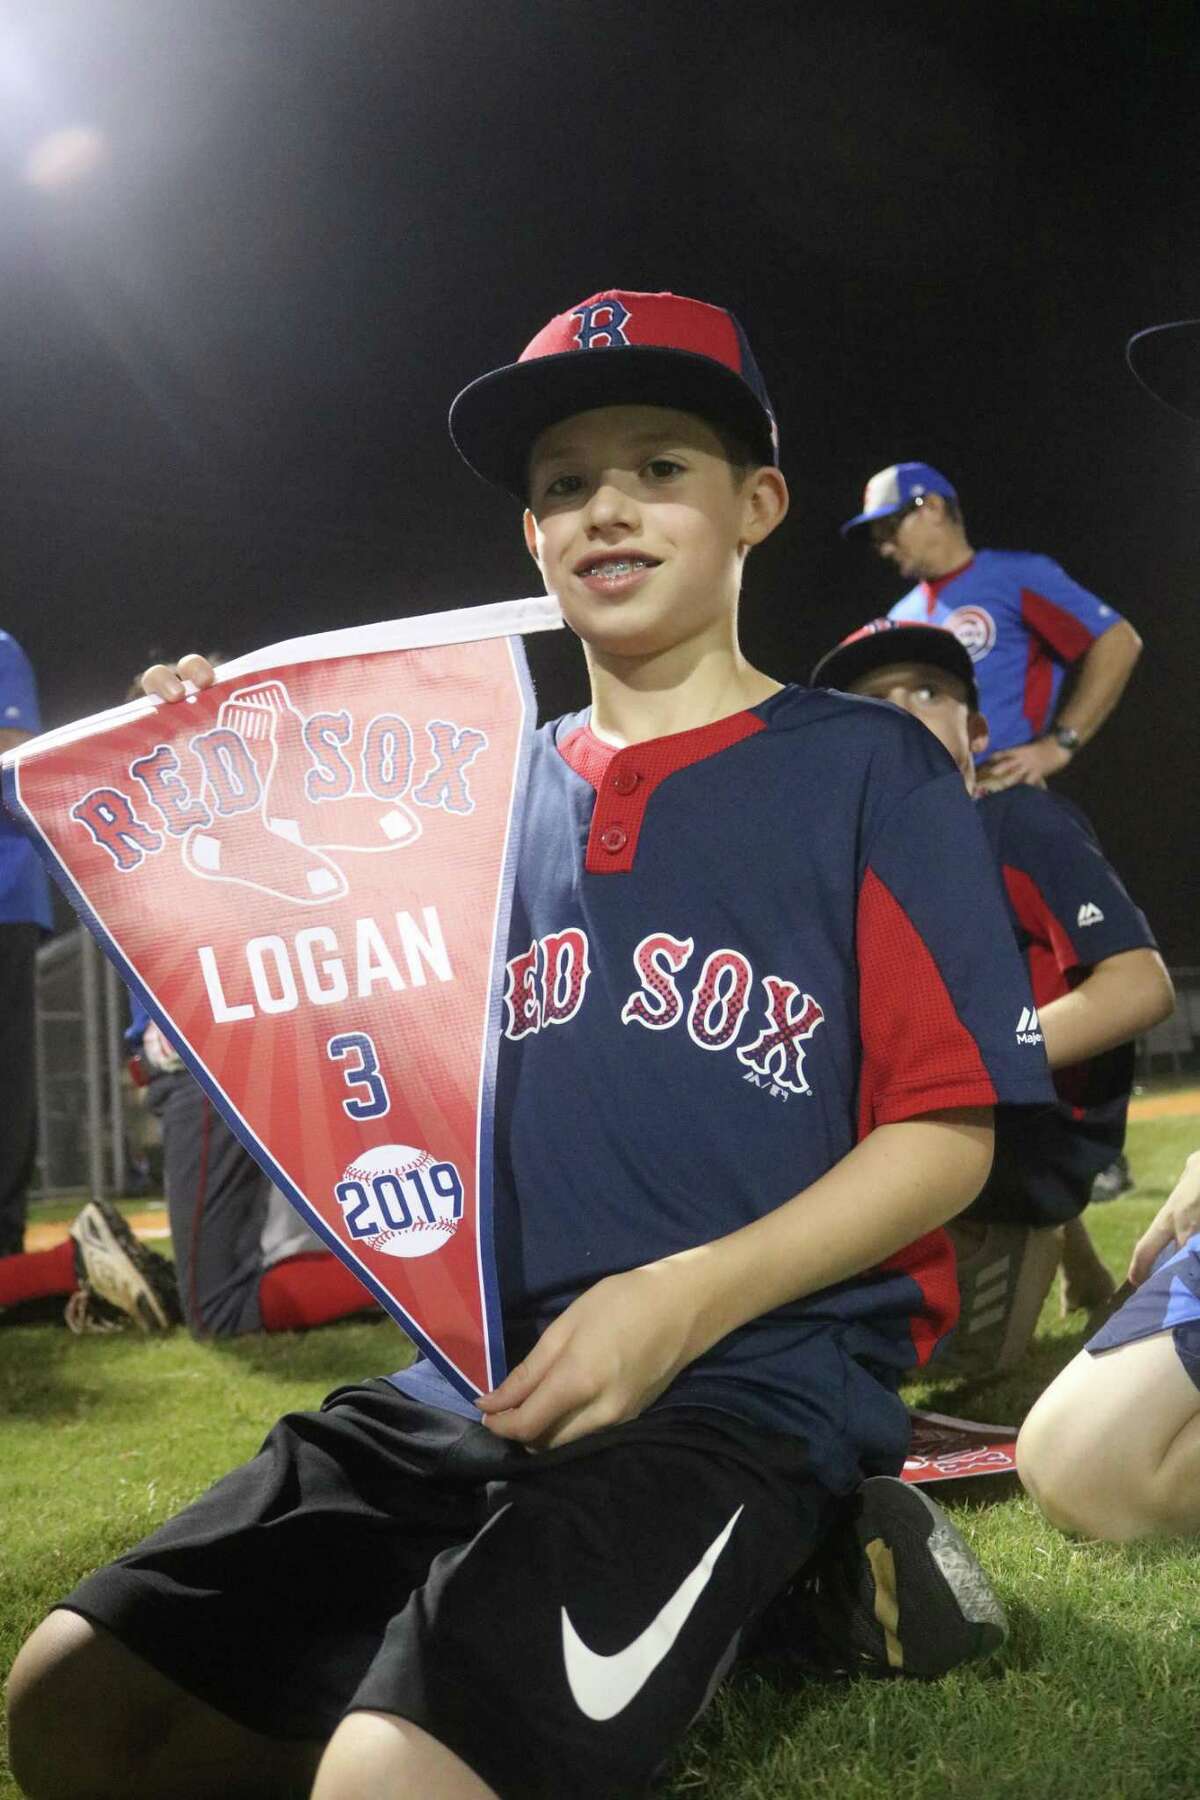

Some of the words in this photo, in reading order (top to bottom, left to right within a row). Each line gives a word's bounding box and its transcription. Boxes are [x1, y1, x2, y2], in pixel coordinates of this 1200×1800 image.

[70, 727, 262, 872] RED
[302, 710, 488, 814] SOX
[198, 906, 454, 1024] LOGAN
[503, 927, 592, 1041] ED
[621, 932, 825, 1093] SOX
[327, 1031, 391, 1121] 3
[335, 1160, 464, 1239] 2019
